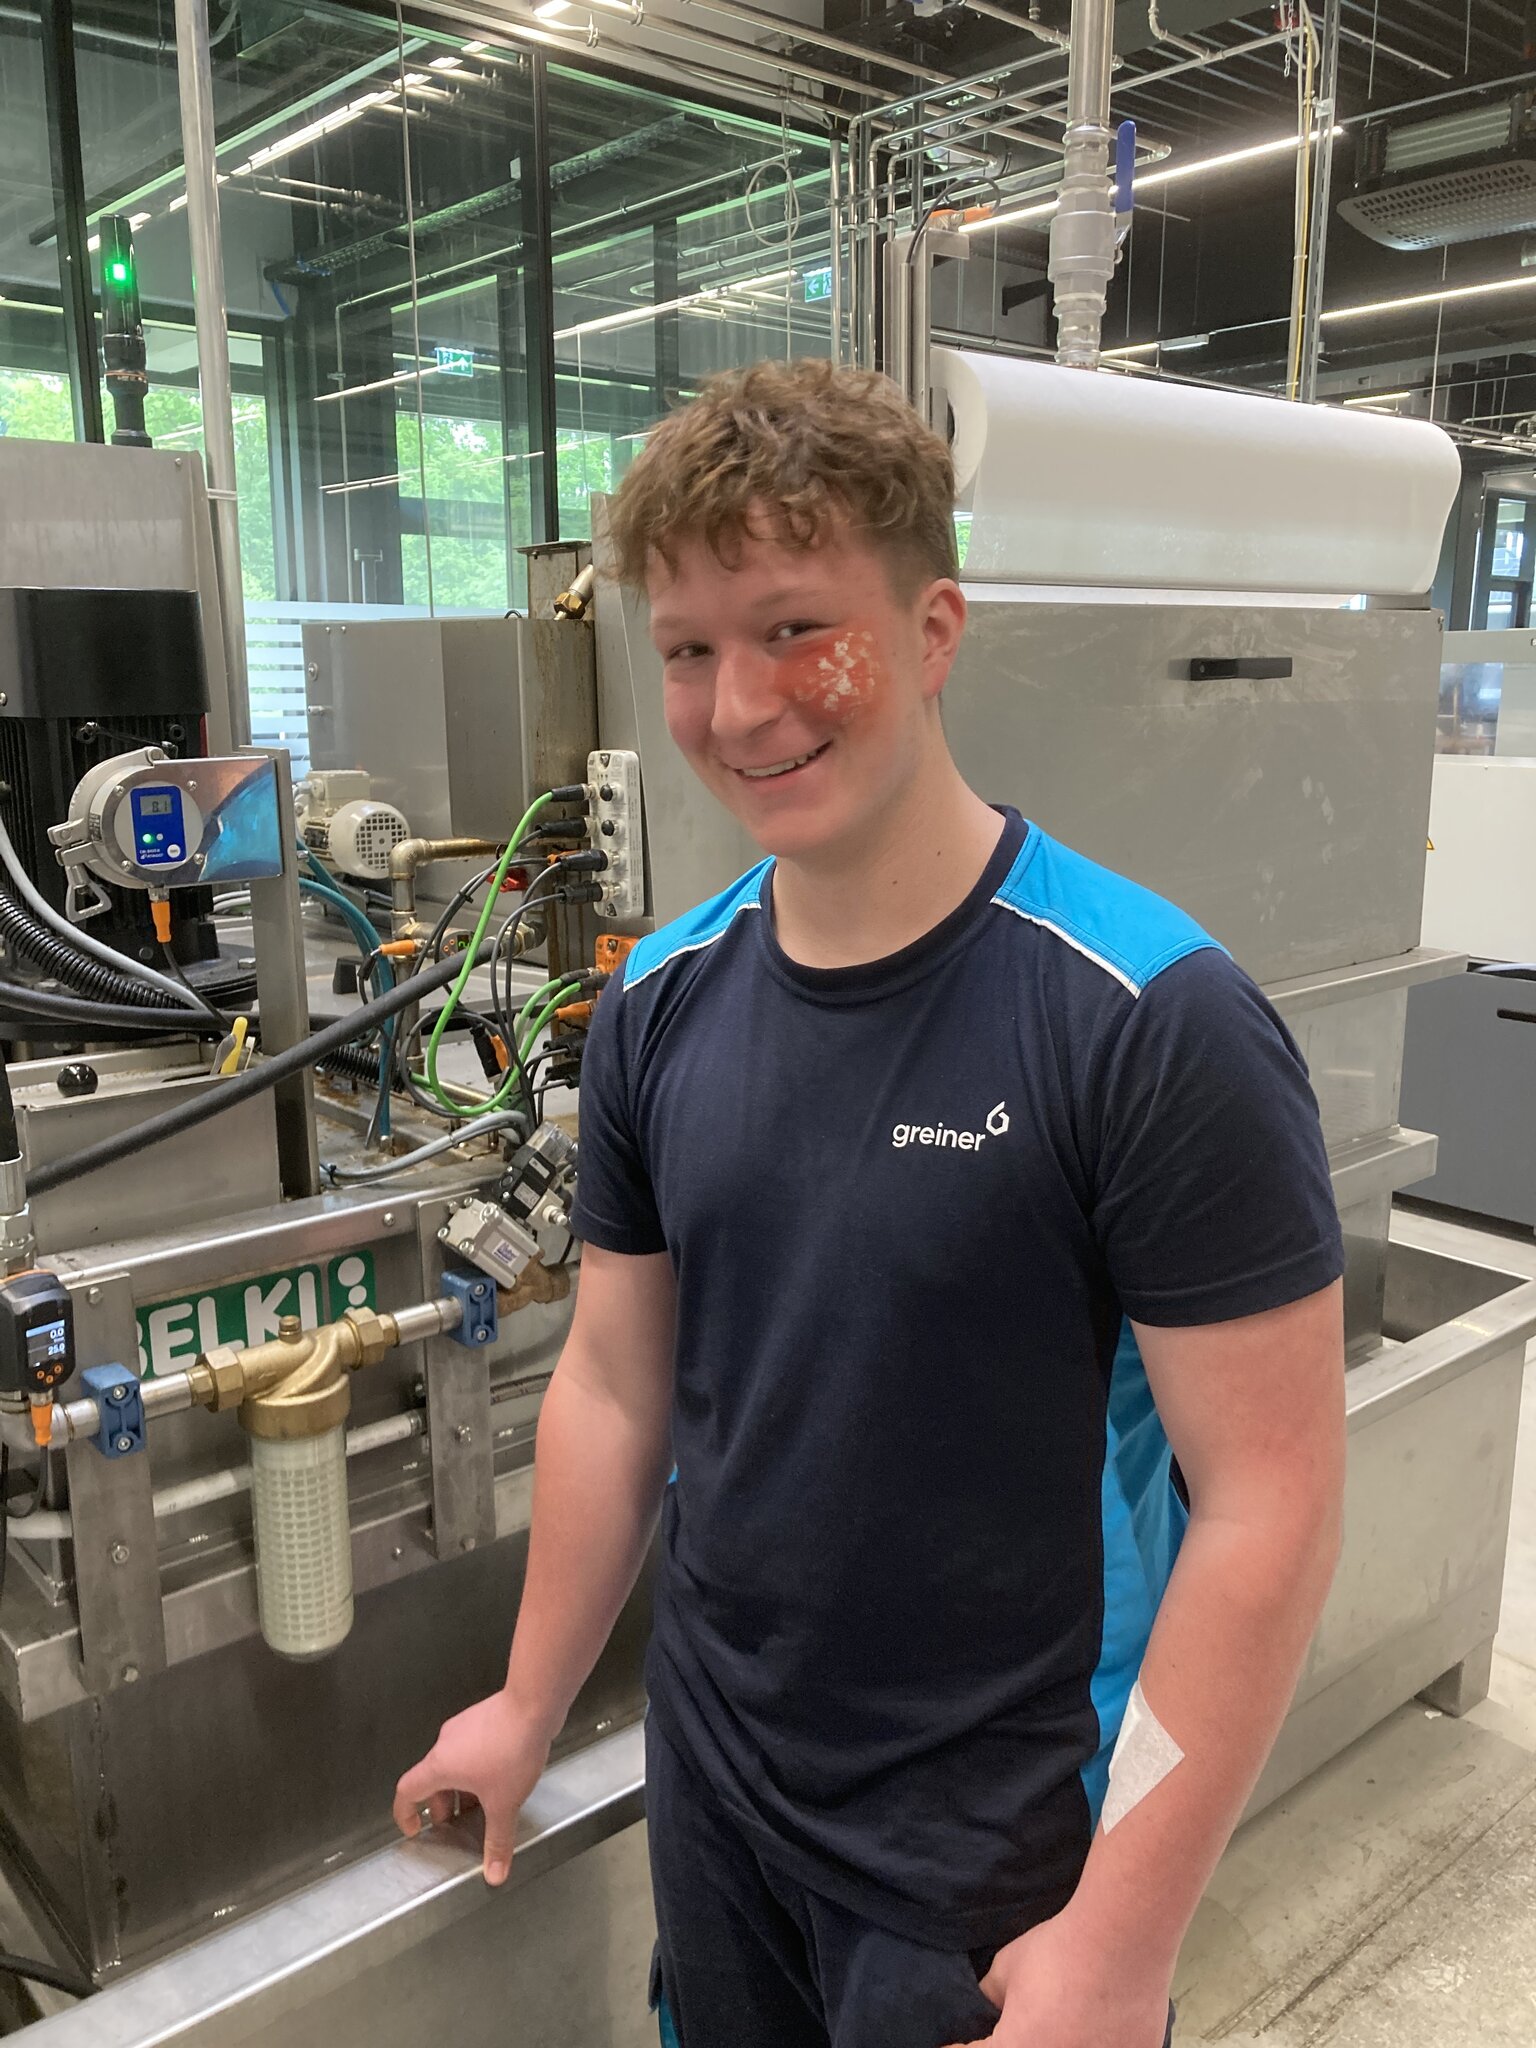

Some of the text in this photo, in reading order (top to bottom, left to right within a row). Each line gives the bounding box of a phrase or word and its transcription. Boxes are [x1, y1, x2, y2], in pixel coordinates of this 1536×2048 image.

[891, 1121, 986, 1151] greiner
[50, 1327, 65, 1340] 0.0
[136, 1270, 319, 1377] ELKI
[47, 1342, 66, 1356] 25.0
